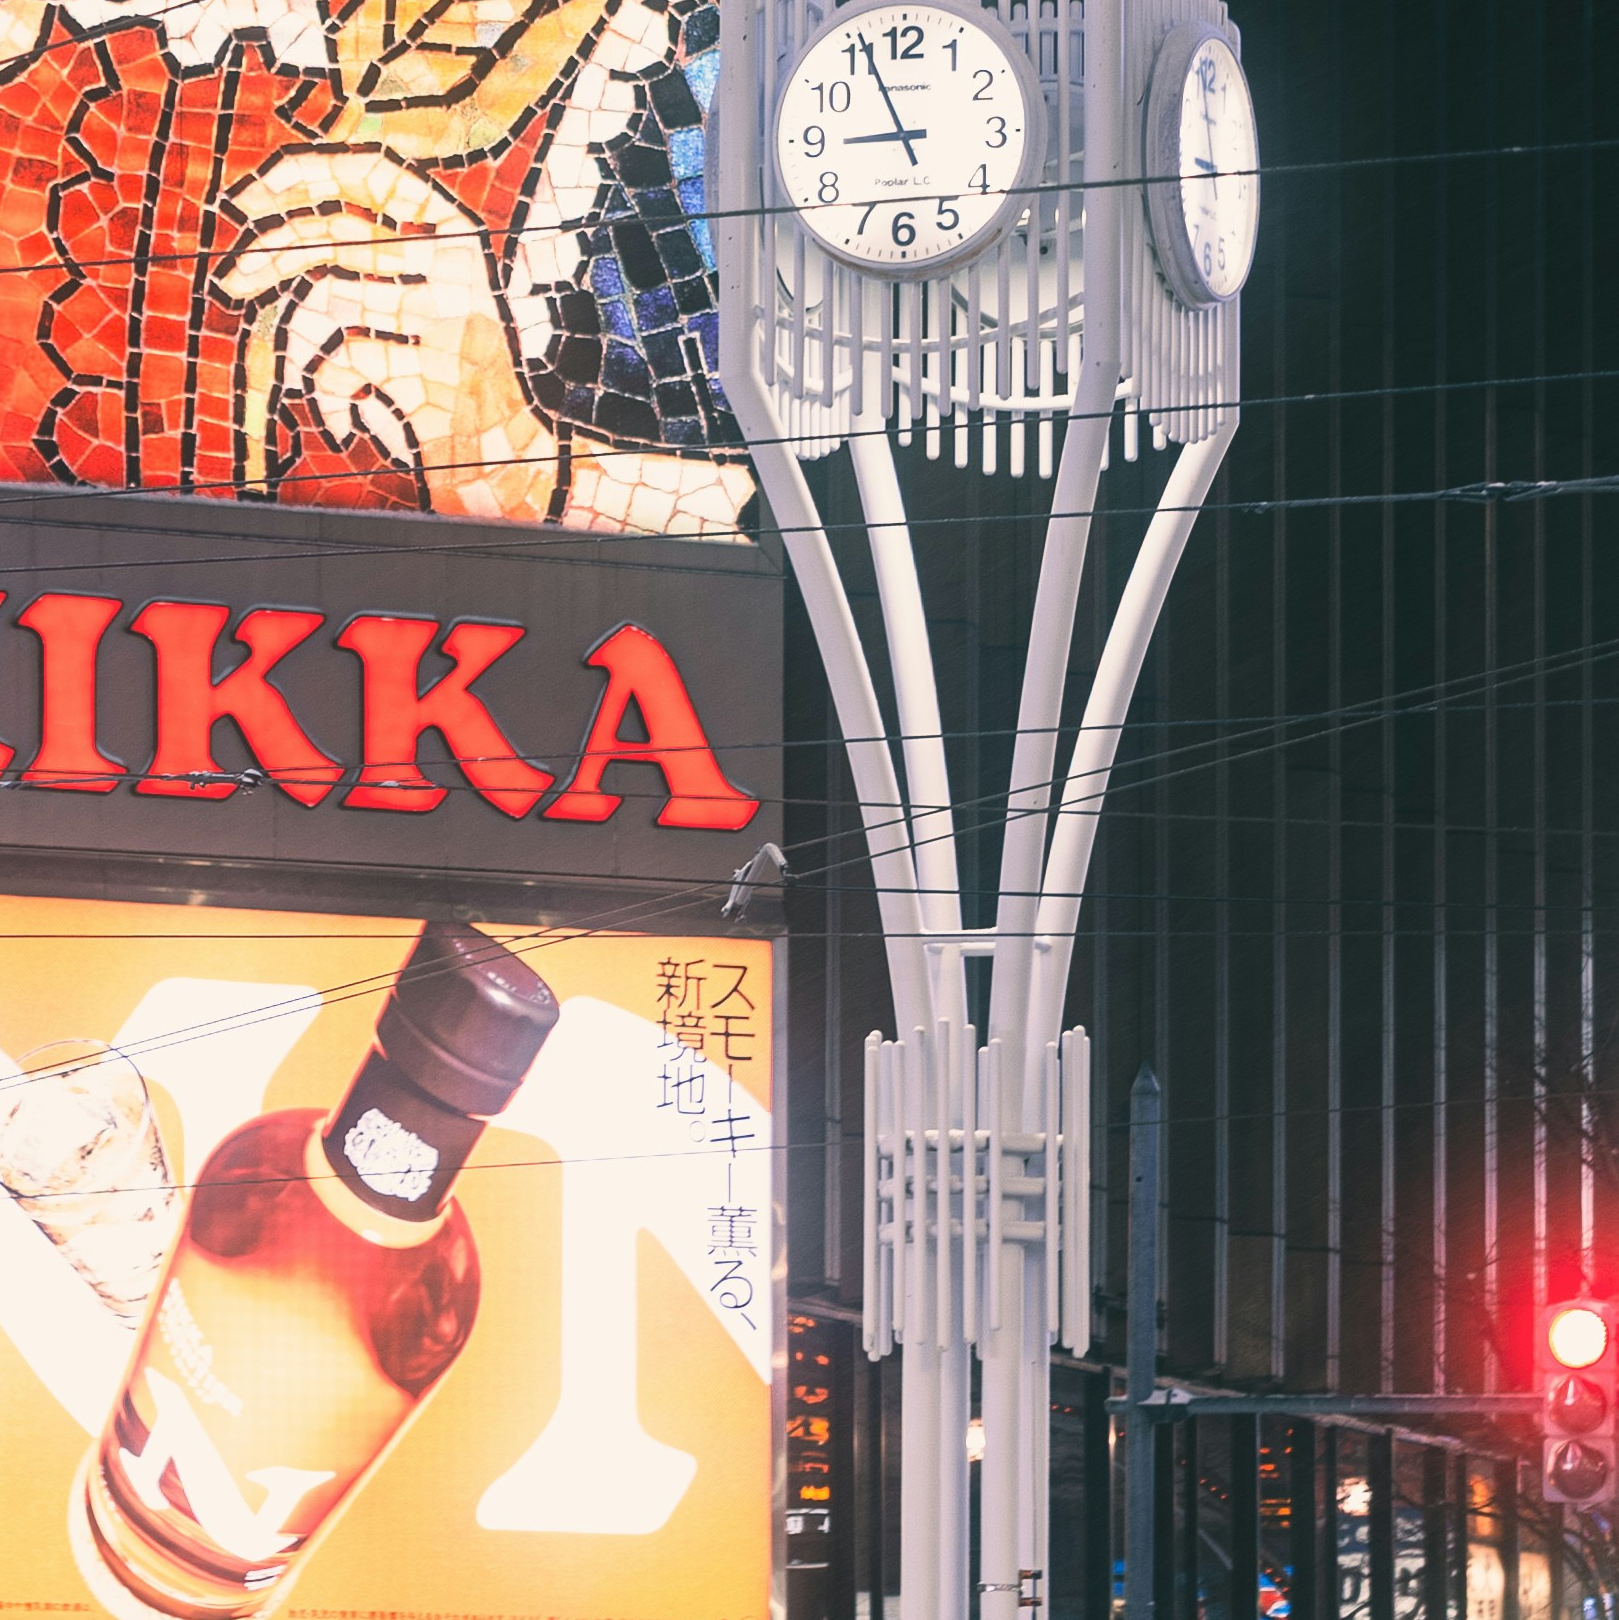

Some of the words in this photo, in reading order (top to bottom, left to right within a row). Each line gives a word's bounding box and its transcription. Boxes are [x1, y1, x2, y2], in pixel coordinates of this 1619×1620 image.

[882, 25, 925, 60] 12
[942, 39, 957, 72] 1
[811, 81, 851, 113] 10
[972, 69, 994, 101] 2
[803, 125, 826, 158] 9
[985, 116, 1008, 149] 3
[817, 171, 840, 203] 8
[967, 164, 991, 195] 4
[852, 203, 878, 235] 7
[891, 212, 916, 247] 6
[935, 196, 960, 231] 5
[656, 957, 707, 1143] 新境地。
[708, 962, 757, 1331] スモーキー薫る、
